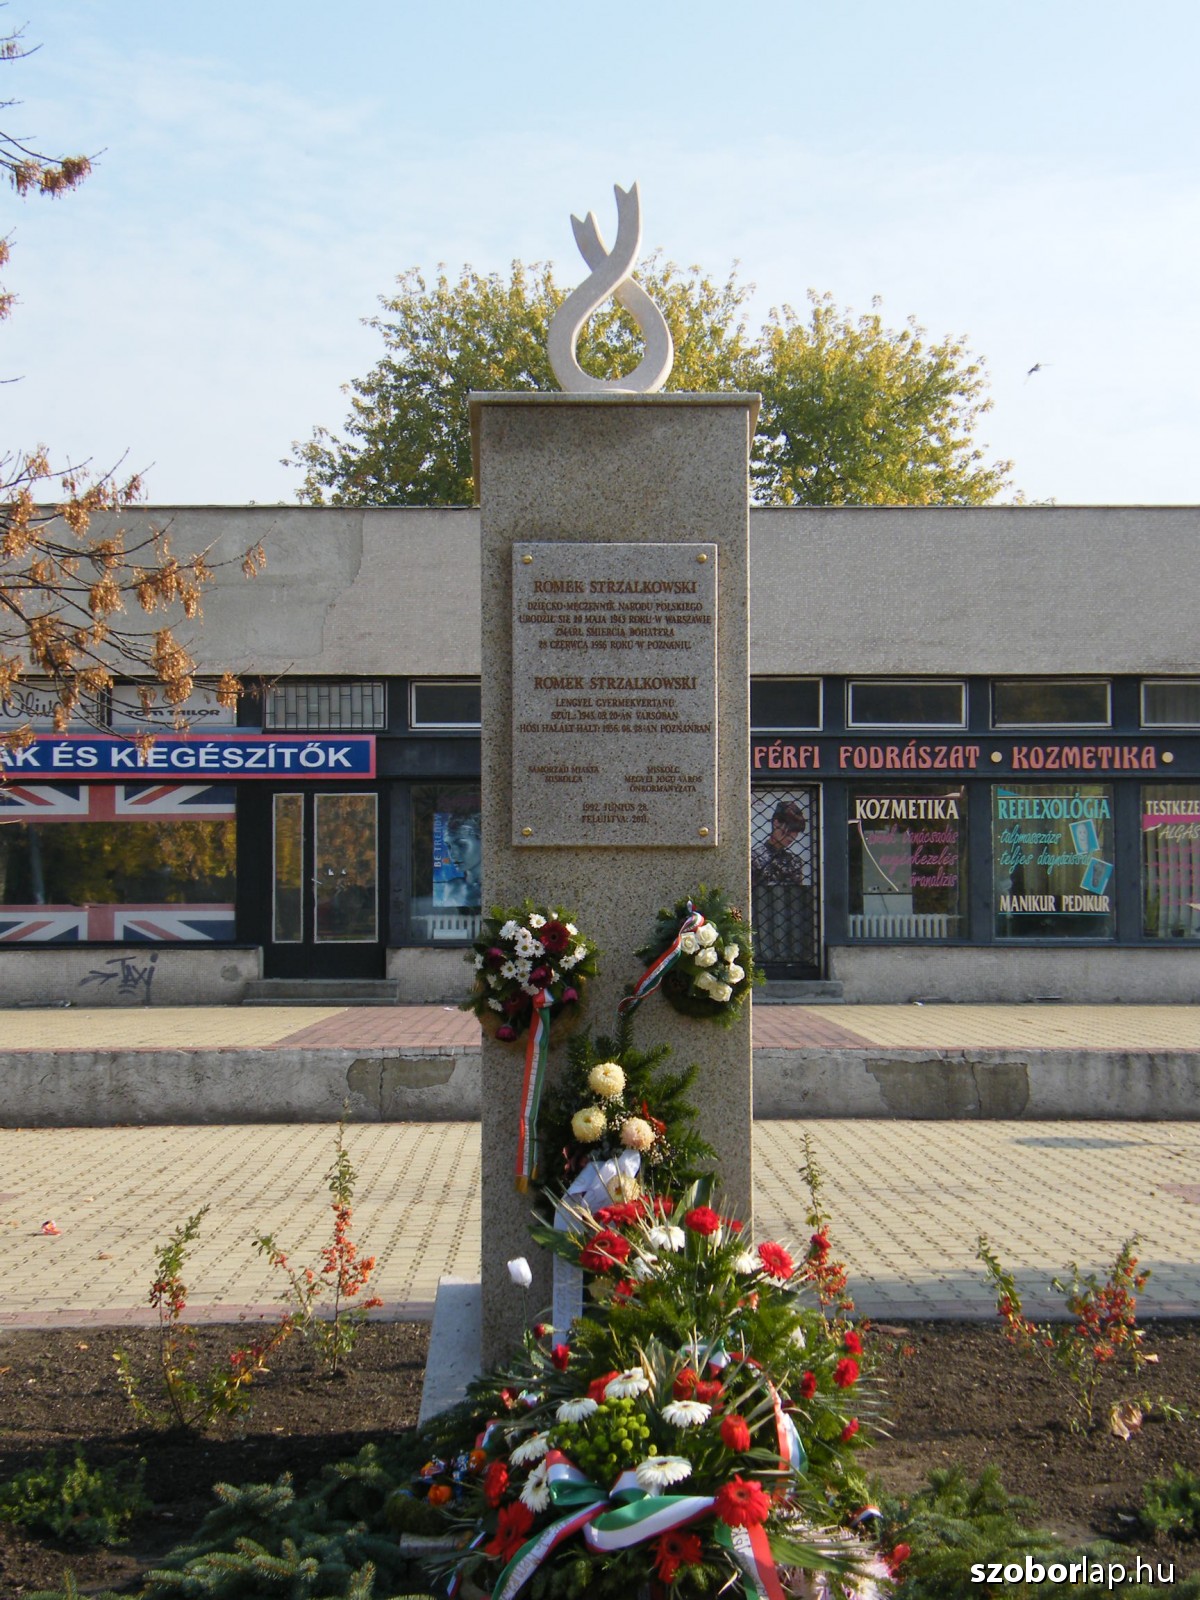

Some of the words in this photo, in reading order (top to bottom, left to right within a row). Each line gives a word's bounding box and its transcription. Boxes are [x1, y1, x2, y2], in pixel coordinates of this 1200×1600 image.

[534, 580, 584, 594] ROMEK
[656, 602, 703, 611] POLSKIEGO
[534, 677, 584, 690] ROMEK
[52, 742, 98, 767] ÉS
[111, 742, 352, 768] KIEGÉSZÍTŐK
[754, 739, 820, 769] FÉRFI
[839, 739, 980, 769] FODRÁSZAT
[1012, 746, 1157, 769] KOZMETIKA
[855, 799, 959, 819] KOZMETIKA
[1000, 895, 1056, 912] MANIKUR
[1062, 895, 1110, 912] PEDIKUR
